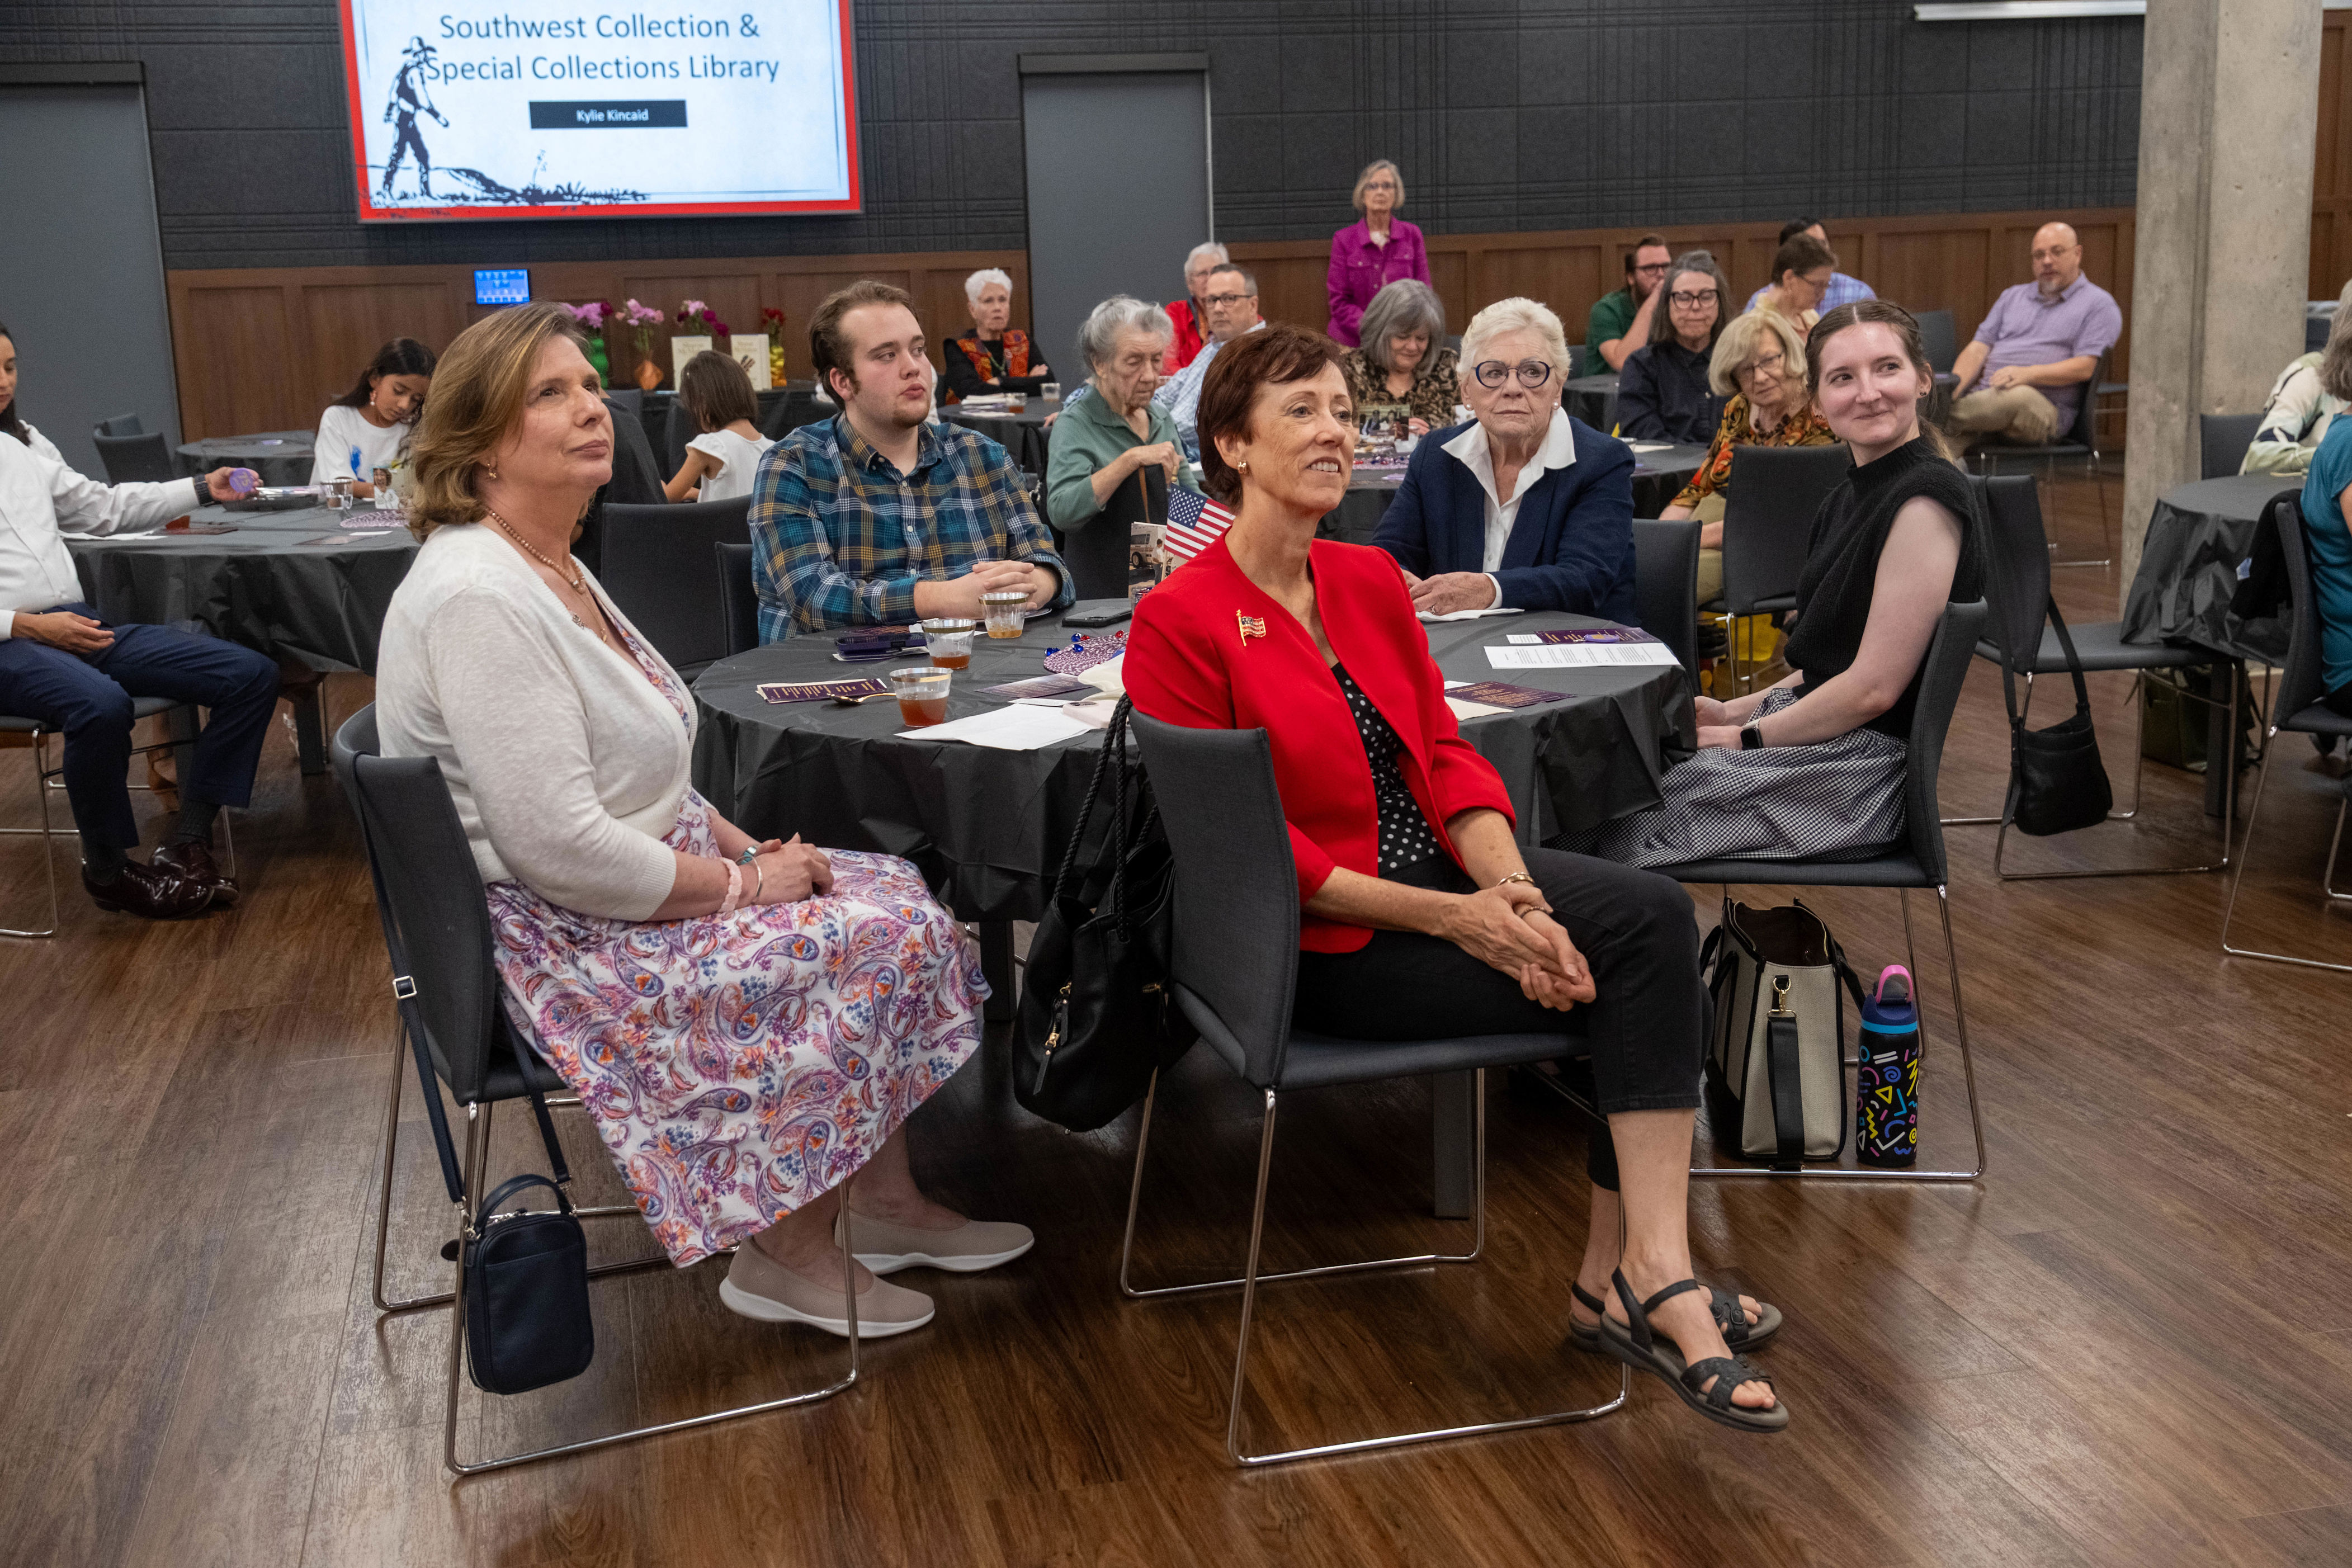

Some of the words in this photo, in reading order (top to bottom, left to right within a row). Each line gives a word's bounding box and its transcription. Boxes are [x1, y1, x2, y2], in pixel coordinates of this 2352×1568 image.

[440, 13, 587, 38] Southwest
[596, 13, 729, 37] Collection
[740, 13, 759, 37] &
[427, 54, 521, 85] Special
[532, 54, 680, 79] Collections
[689, 54, 779, 83] Library
[576, 109, 605, 124] Kylie
[606, 108, 649, 121] Kincaid
